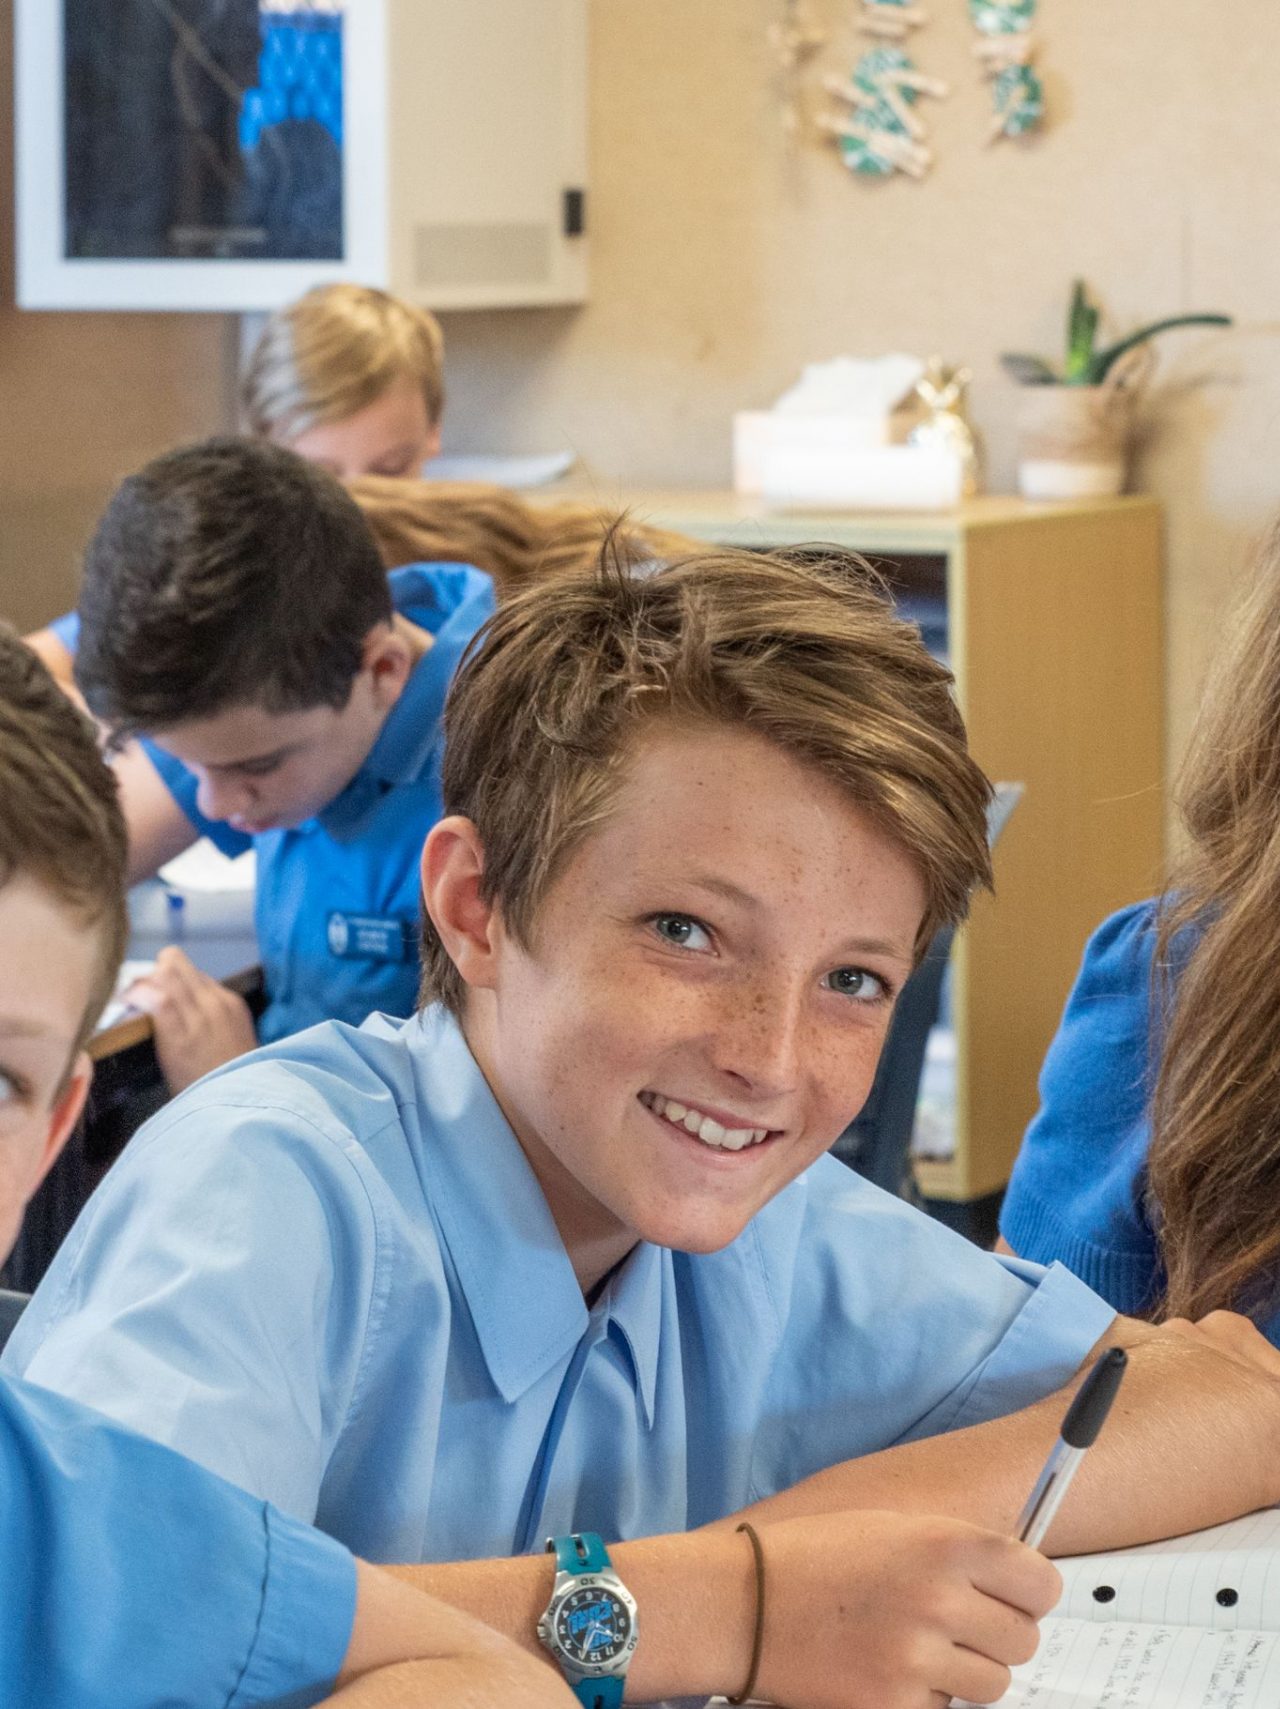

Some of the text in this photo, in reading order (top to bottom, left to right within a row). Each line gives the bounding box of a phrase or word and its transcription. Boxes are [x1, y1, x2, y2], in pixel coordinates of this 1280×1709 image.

[613, 1634, 625, 1642] 10
[605, 1646, 614, 1655] 11
[590, 1652, 601, 1661] 12
